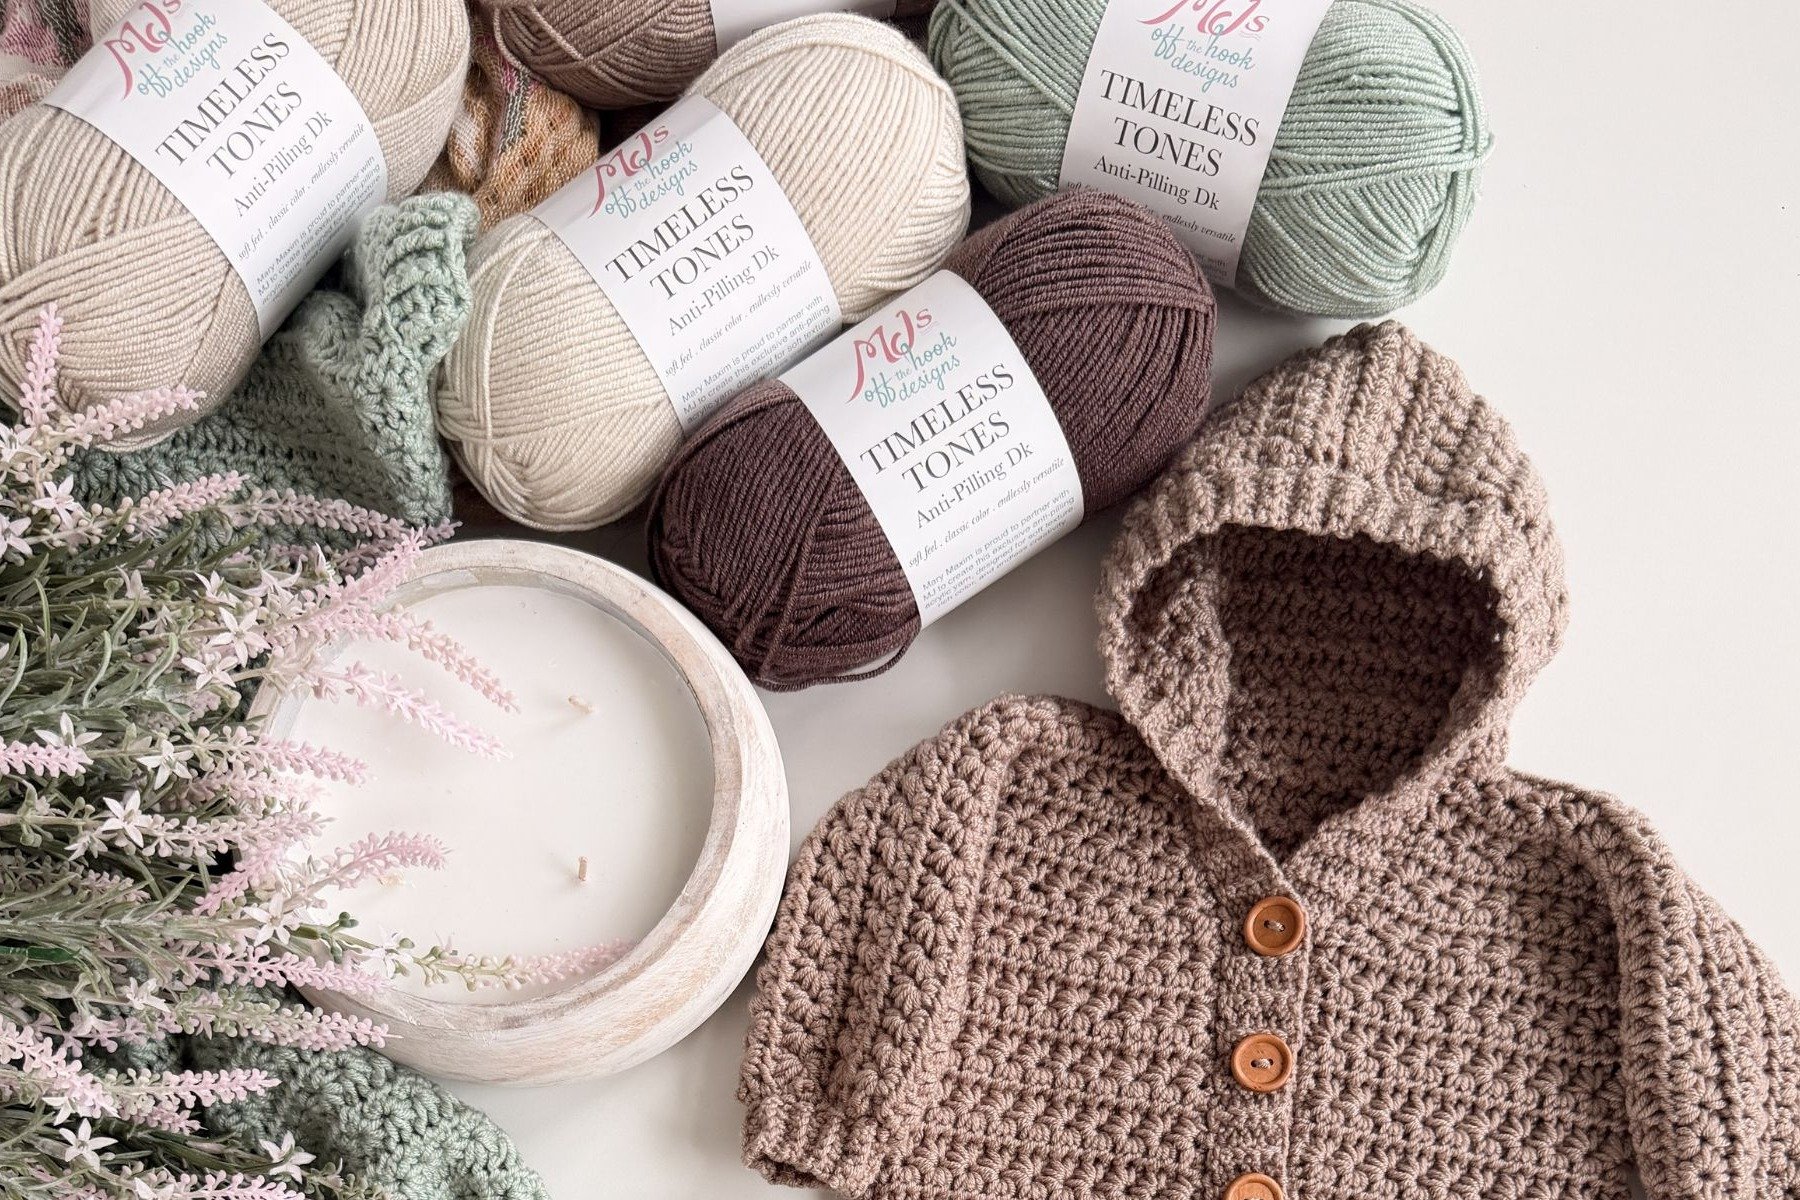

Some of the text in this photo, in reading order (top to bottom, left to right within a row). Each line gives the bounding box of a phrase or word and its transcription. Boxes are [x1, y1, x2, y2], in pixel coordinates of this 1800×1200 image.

[137, 12, 216, 98] off the hook
[174, 32, 228, 87] designs
[1151, 24, 1255, 70] off the hook
[1171, 54, 1238, 93] designs
[155, 32, 289, 165] TIMELESS
[206, 81, 302, 177] TONES
[1101, 70, 1259, 146] TIMELESS
[234, 111, 332, 217] Anti-Pilling Dk
[605, 141, 693, 219] off the hook
[639, 160, 698, 209] designs
[1093, 155, 1219, 210] Anti-Pilling Dk
[1114, 117, 1222, 176] TONES
[605, 165, 753, 283] TIMELESS
[649, 214, 753, 299] TONES
[669, 245, 779, 336] Anti-Pilling Dk
[864, 331, 957, 408] off the hook
[899, 354, 960, 401] designs
[860, 363, 1013, 475] TIMELESS
[901, 411, 1009, 493] TONES
[917, 442, 1033, 528] Anti-Pilling Dk
